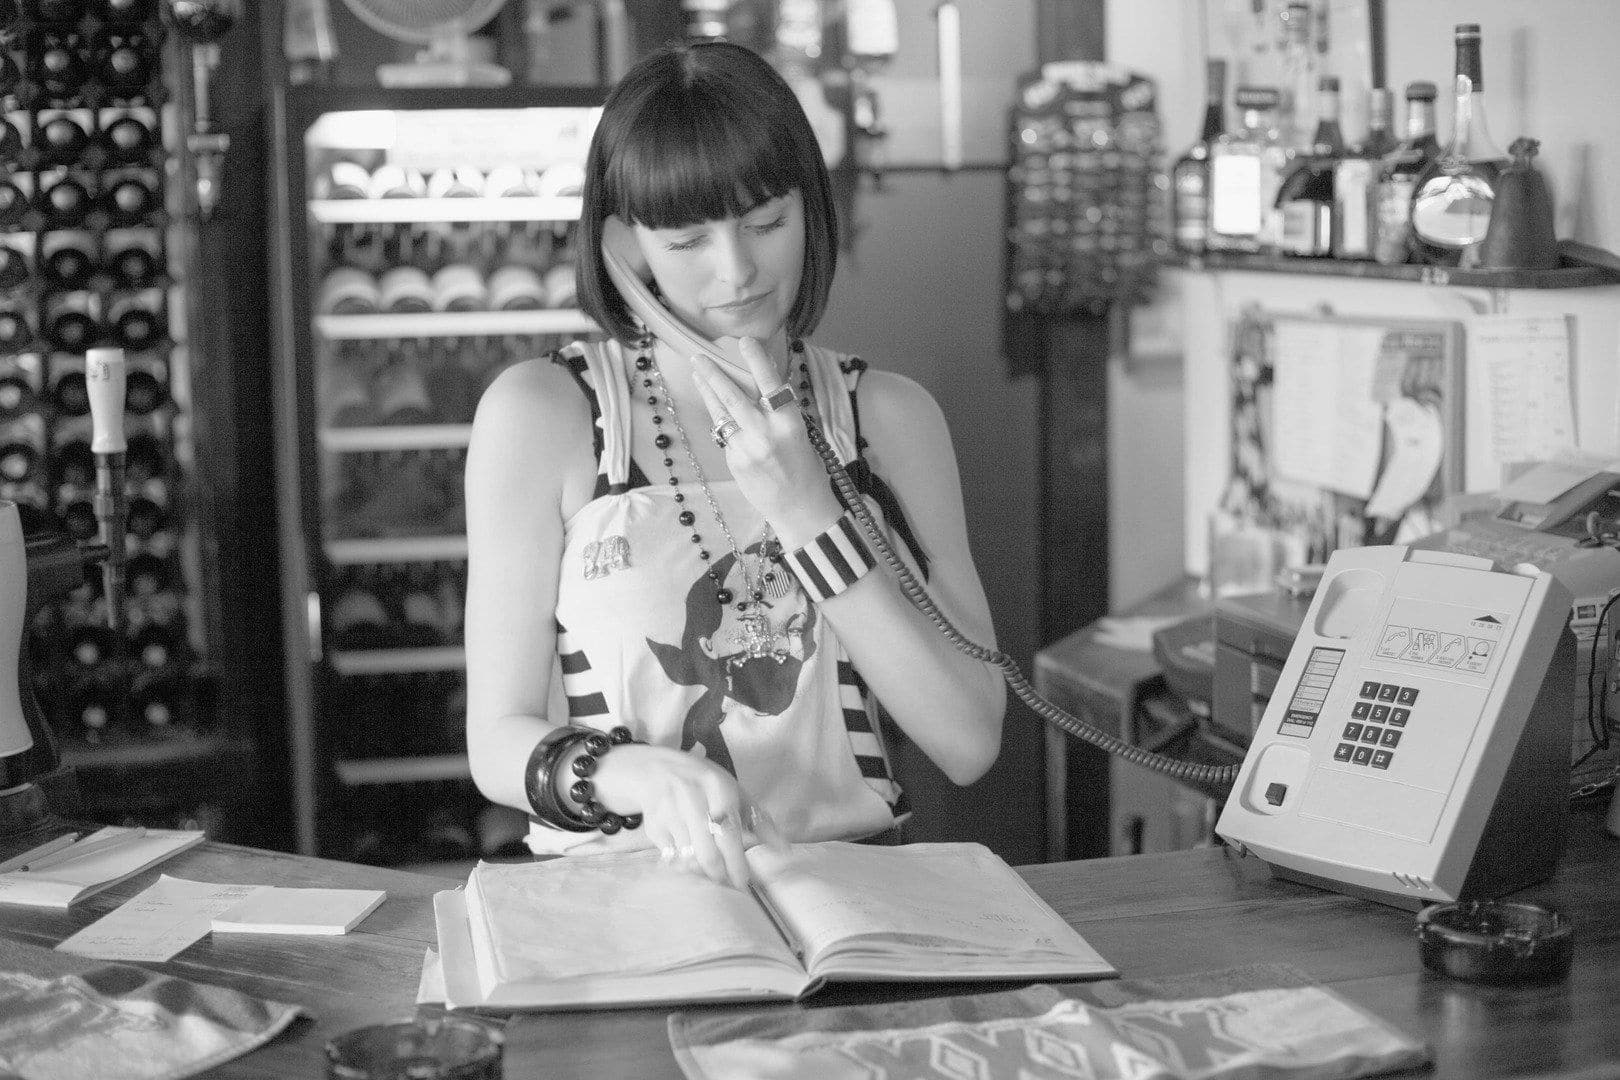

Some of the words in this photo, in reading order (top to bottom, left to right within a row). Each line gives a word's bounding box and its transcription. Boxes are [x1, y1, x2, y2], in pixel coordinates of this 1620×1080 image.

[1383, 688, 1390, 697] 2
[1403, 691, 1410, 700] 3
[1375, 709, 1382, 718] 5
[1394, 712, 1402, 720] 6
[1348, 726, 1355, 735] 7
[1366, 730, 1374, 739] 8
[1386, 733, 1393, 742] 9
